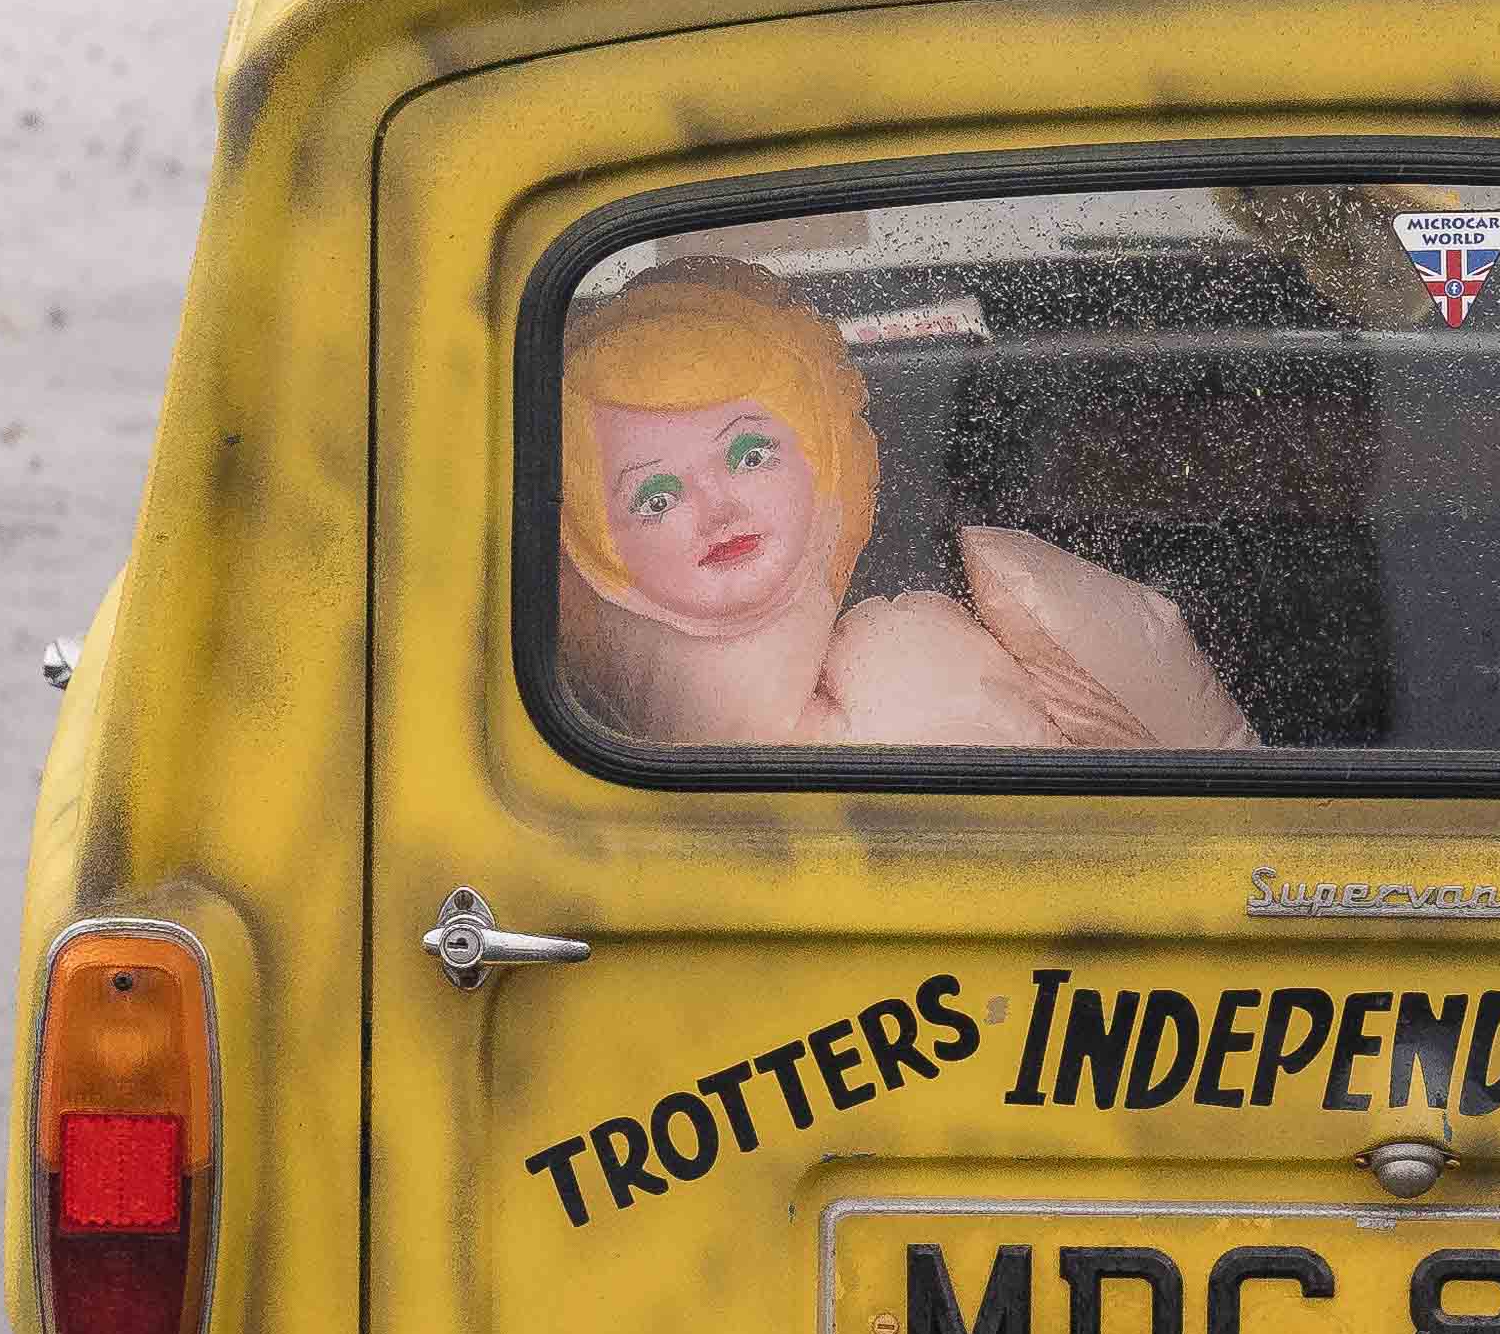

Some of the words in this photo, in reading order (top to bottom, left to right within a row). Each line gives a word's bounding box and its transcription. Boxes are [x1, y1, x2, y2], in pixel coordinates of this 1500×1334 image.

[1406, 217, 1500, 230] MICROCAR
[1422, 233, 1485, 245] WORLD
[1248, 865, 1500, 917] Supervan
[525, 974, 980, 1227] TROTTERS
